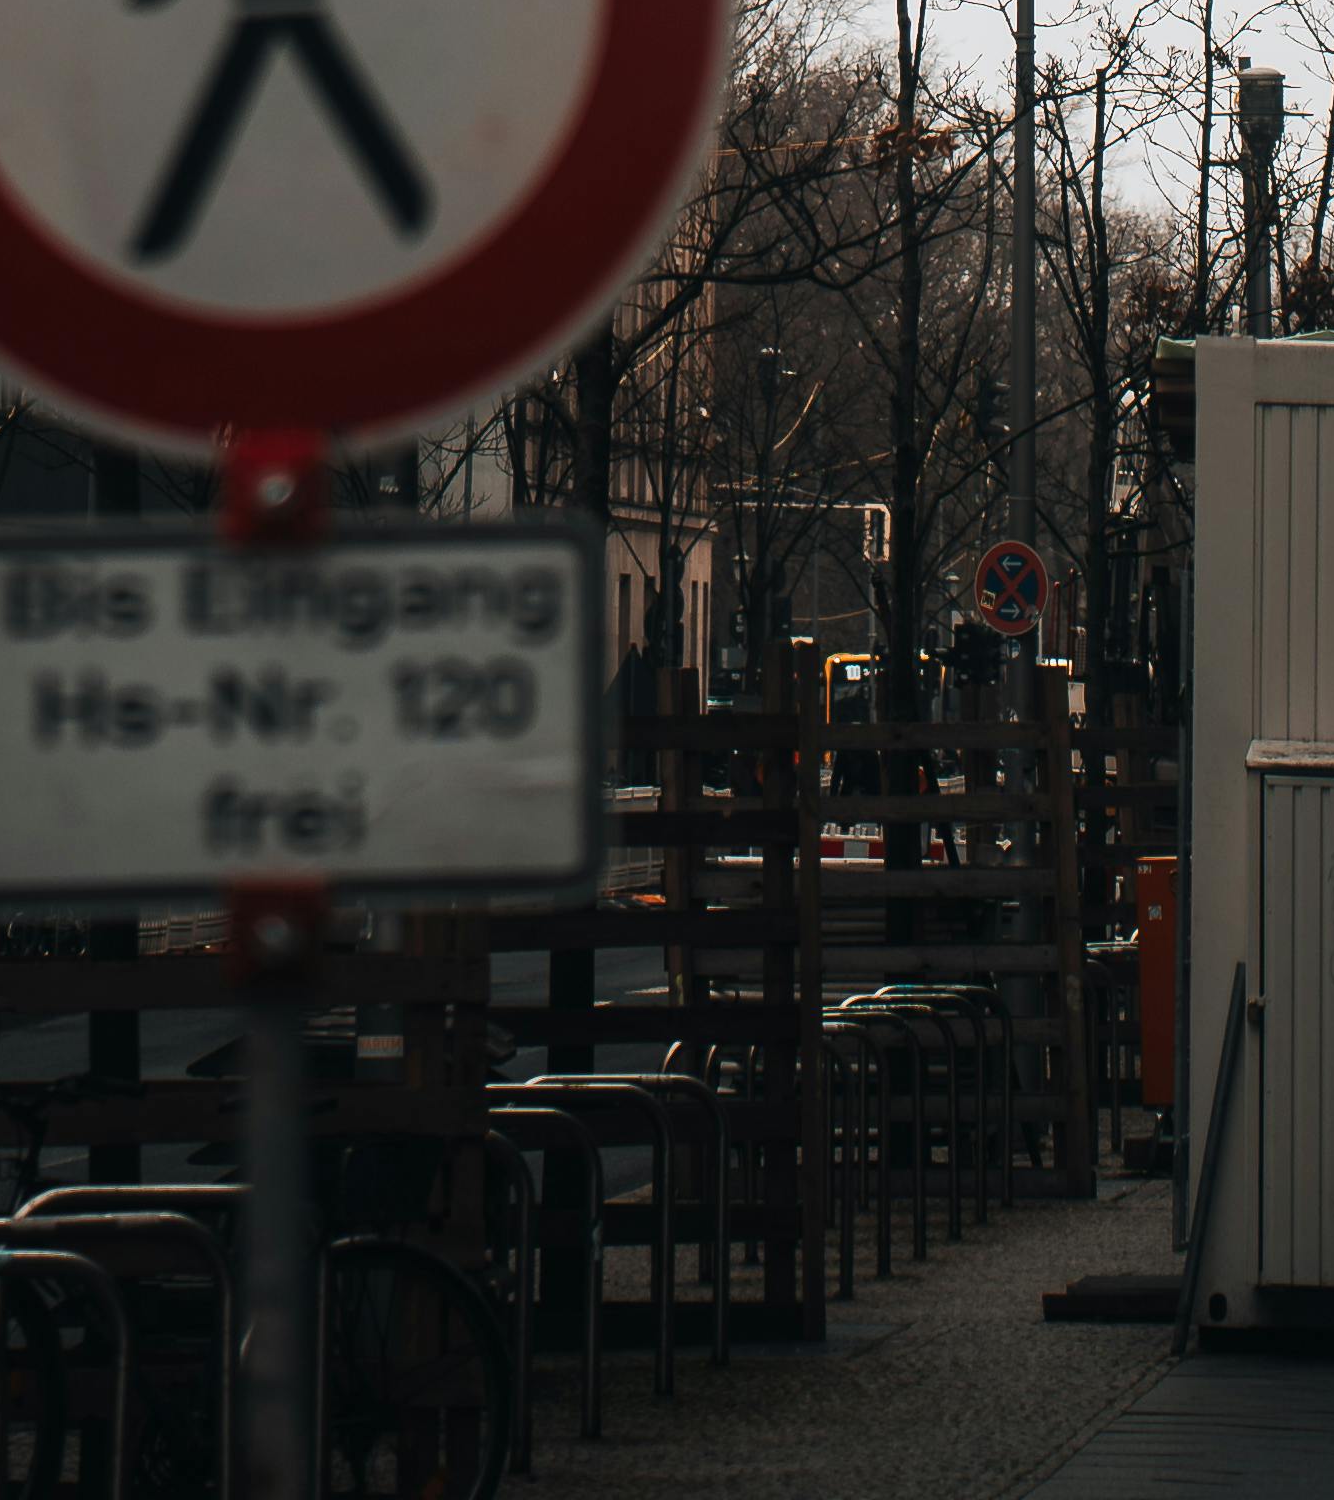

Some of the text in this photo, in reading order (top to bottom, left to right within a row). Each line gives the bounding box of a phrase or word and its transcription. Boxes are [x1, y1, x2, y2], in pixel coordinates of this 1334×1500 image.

[1, 567, 562, 651] Bis Eingang
[390, 658, 538, 742] 120
[201, 769, 367, 855] frei
